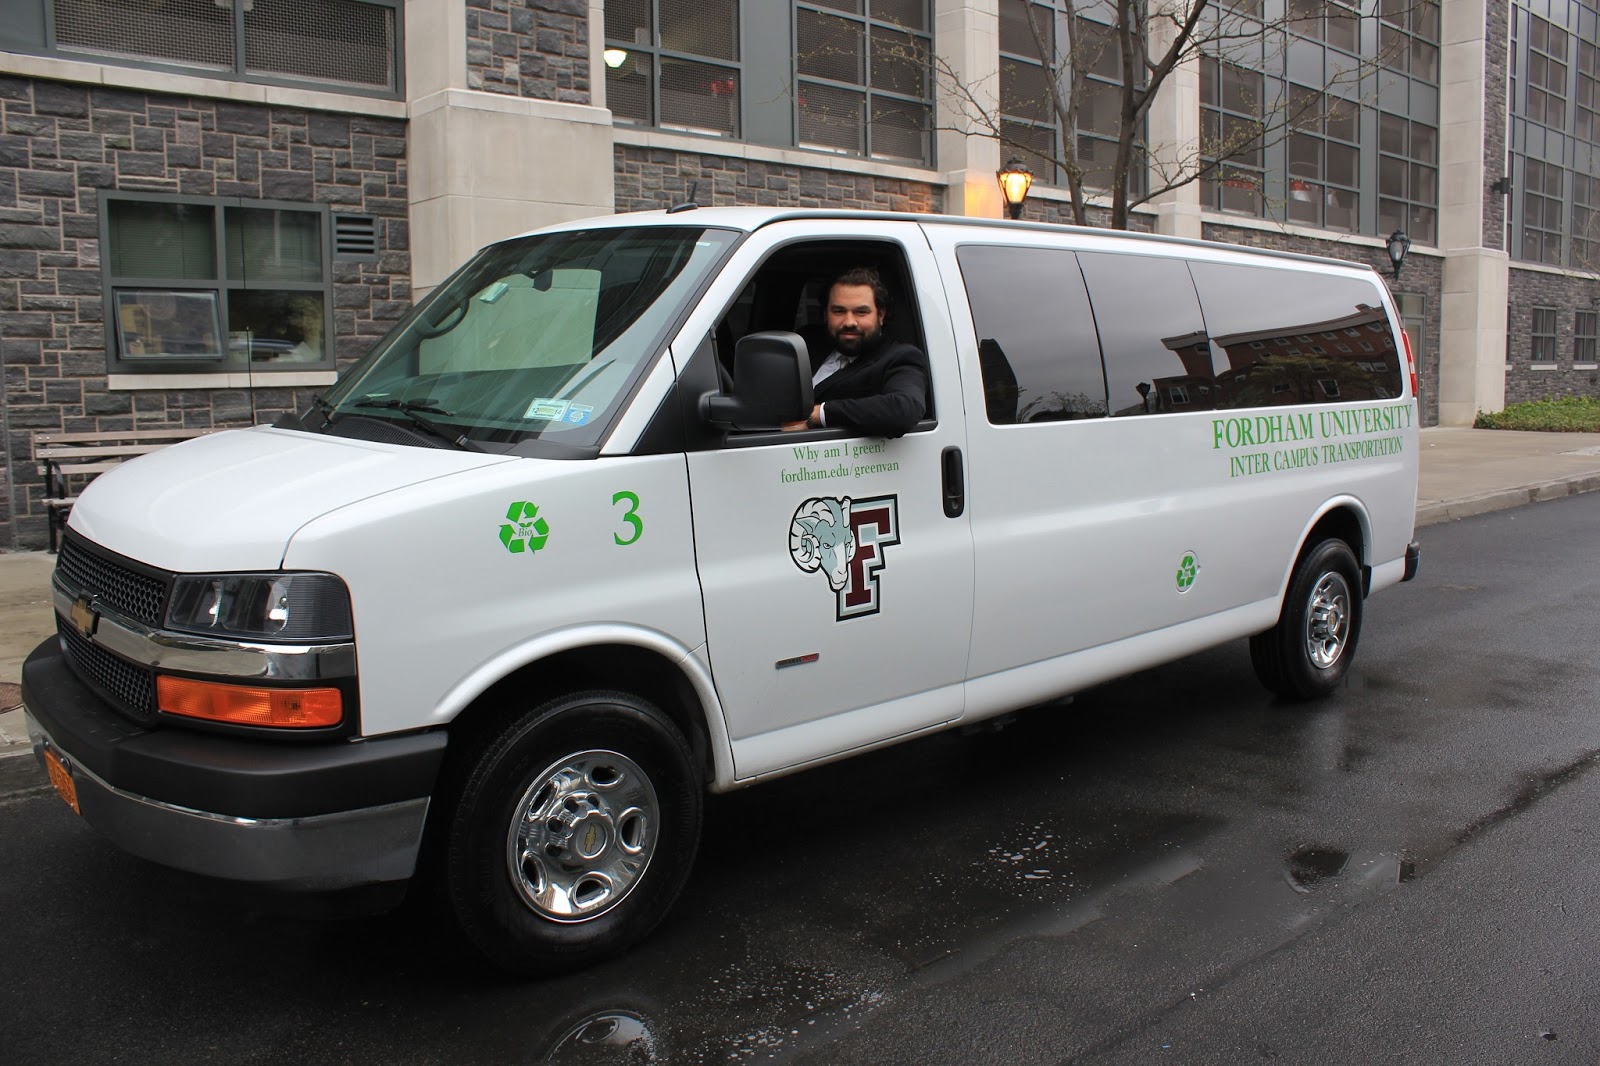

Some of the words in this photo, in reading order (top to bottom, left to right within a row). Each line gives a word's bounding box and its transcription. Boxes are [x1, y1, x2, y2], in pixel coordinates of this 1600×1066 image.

[1212, 413, 1314, 449] FORDHAM
[1319, 404, 1413, 438] UNIVERSITY
[792, 447, 819, 462] Why
[823, 447, 840, 459] am
[844, 442, 849, 456] I
[852, 440, 887, 459] green?
[1230, 451, 1271, 478] INTER
[1273, 447, 1319, 471] CAMPUS
[1321, 436, 1403, 465] TRANSPORTATION
[780, 461, 900, 484] fordham.edu/greenvan
[518, 527, 533, 537] Bio
[612, 490, 643, 546] 3
